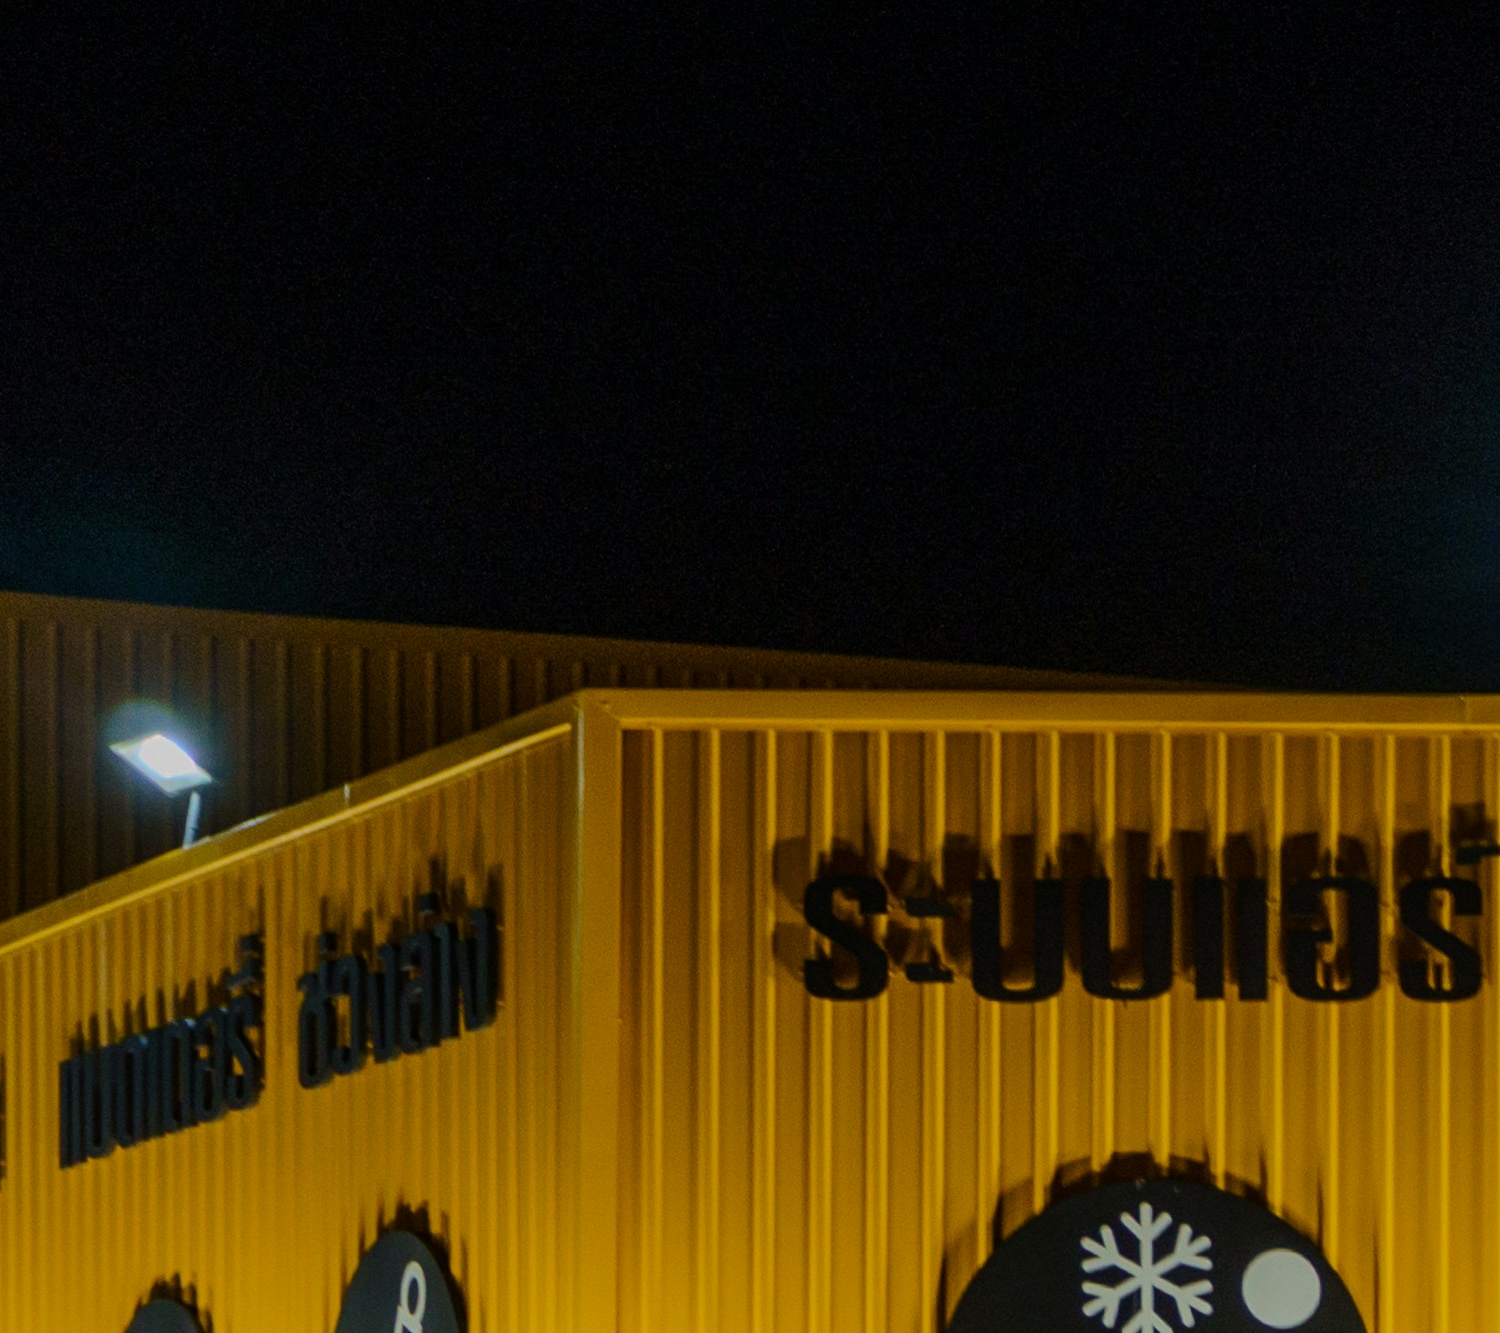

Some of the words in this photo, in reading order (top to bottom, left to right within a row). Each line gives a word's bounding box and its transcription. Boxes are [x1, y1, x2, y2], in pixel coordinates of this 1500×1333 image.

[59, 934, 265, 1169] แบตเตอรี่
[296, 893, 497, 1088] ช่วงล่าง
